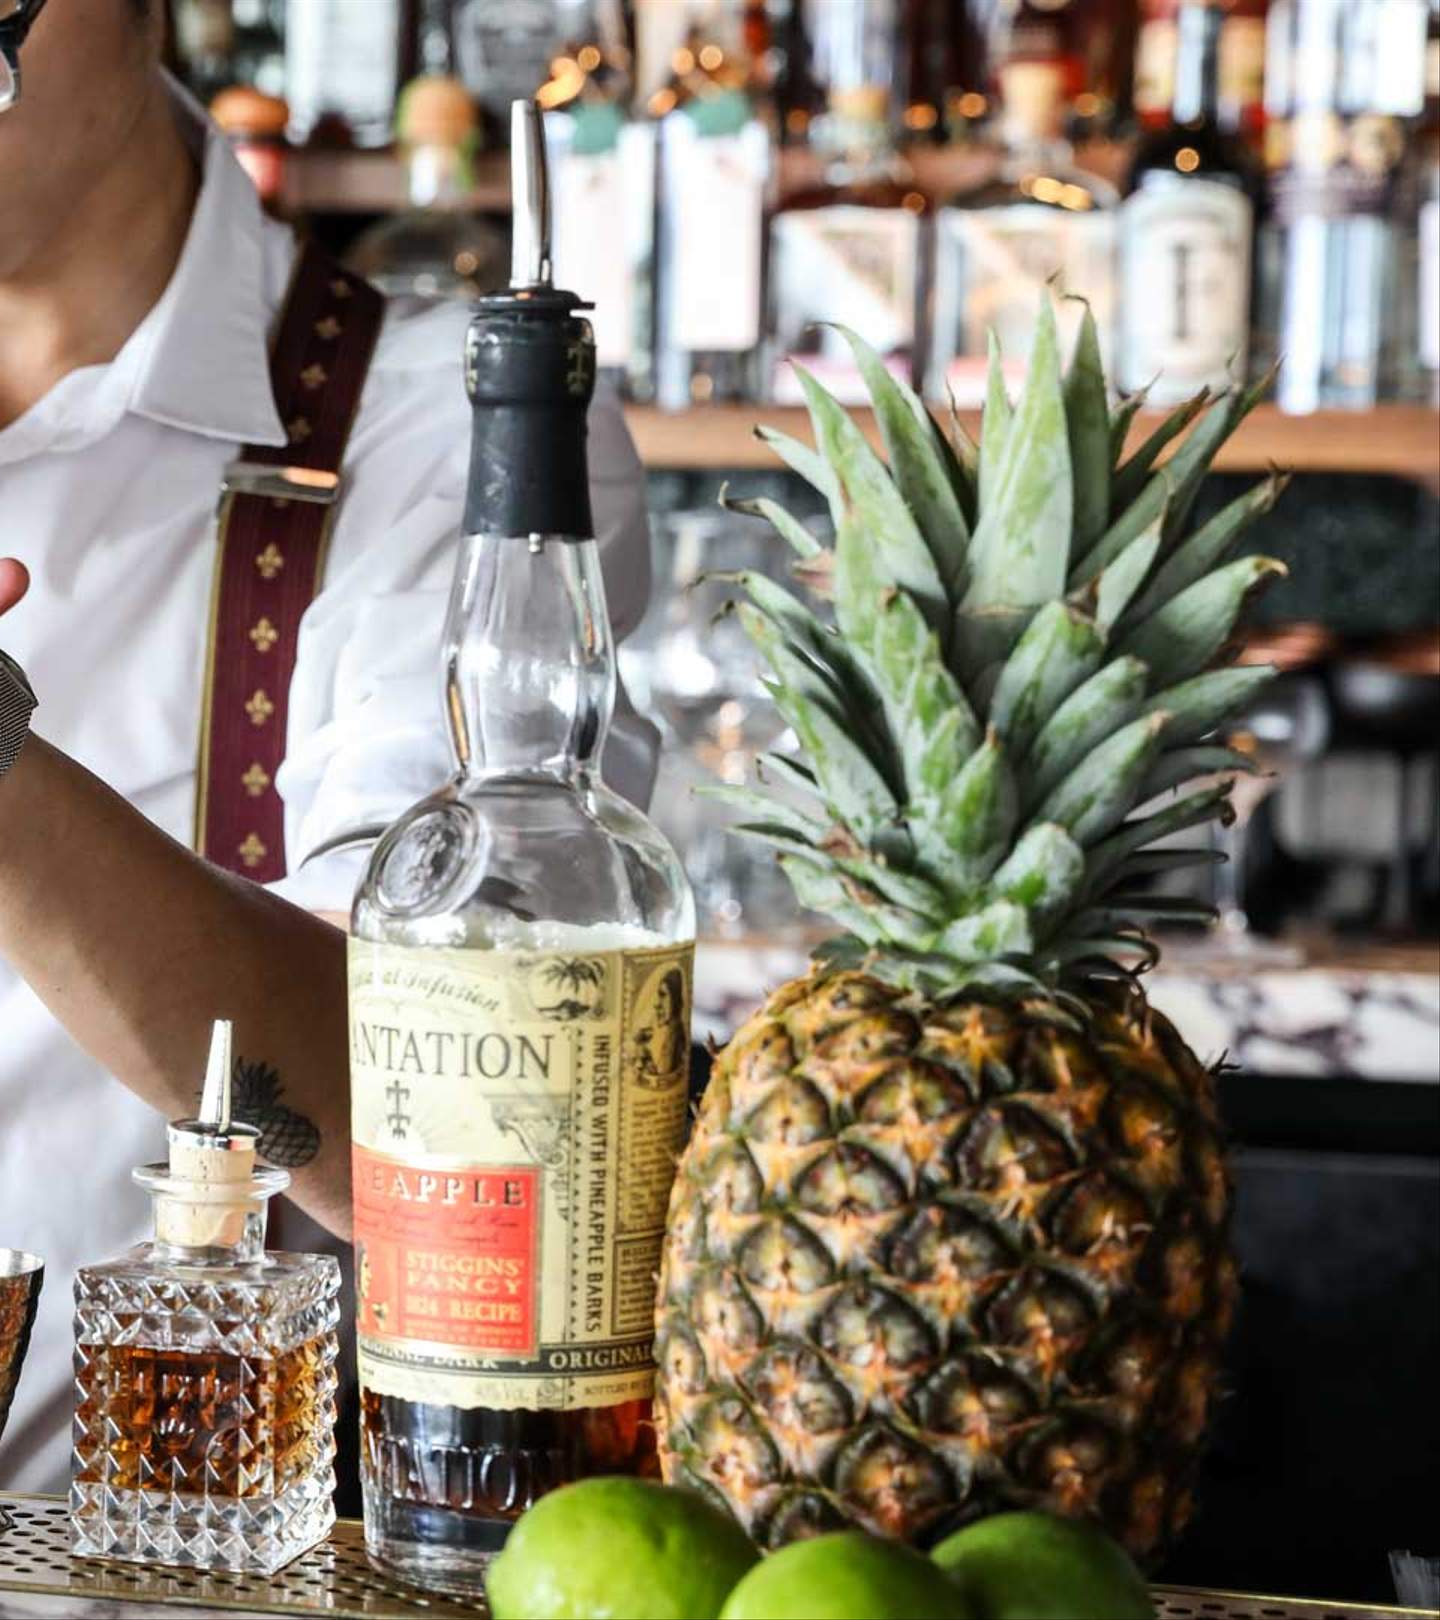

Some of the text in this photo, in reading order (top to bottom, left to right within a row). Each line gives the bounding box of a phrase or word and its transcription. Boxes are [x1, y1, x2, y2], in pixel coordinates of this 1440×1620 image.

[585, 1034, 611, 1334] INFUSED WITH PINEAPPLE BARKS
[407, 1271, 523, 1295] FANCY
[449, 1299, 522, 1322] RECIPE
